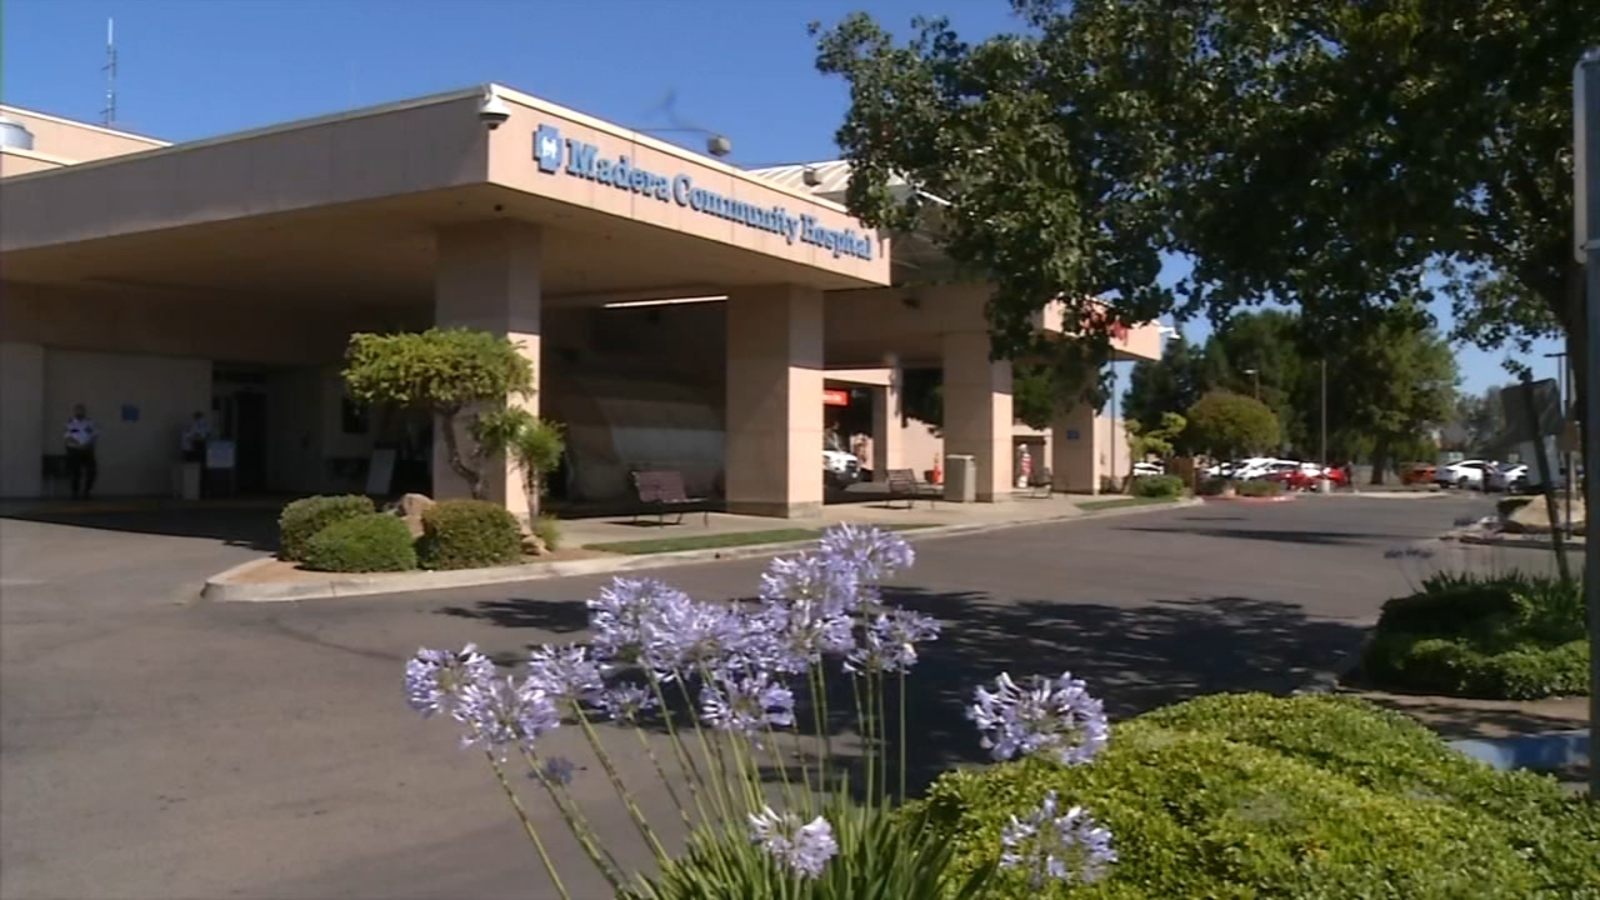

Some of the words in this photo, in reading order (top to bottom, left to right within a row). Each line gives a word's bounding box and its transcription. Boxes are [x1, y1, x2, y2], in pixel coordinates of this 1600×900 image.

[566, 139, 669, 203] Madera
[673, 173, 799, 245] Community
[800, 213, 872, 260] Hospital
